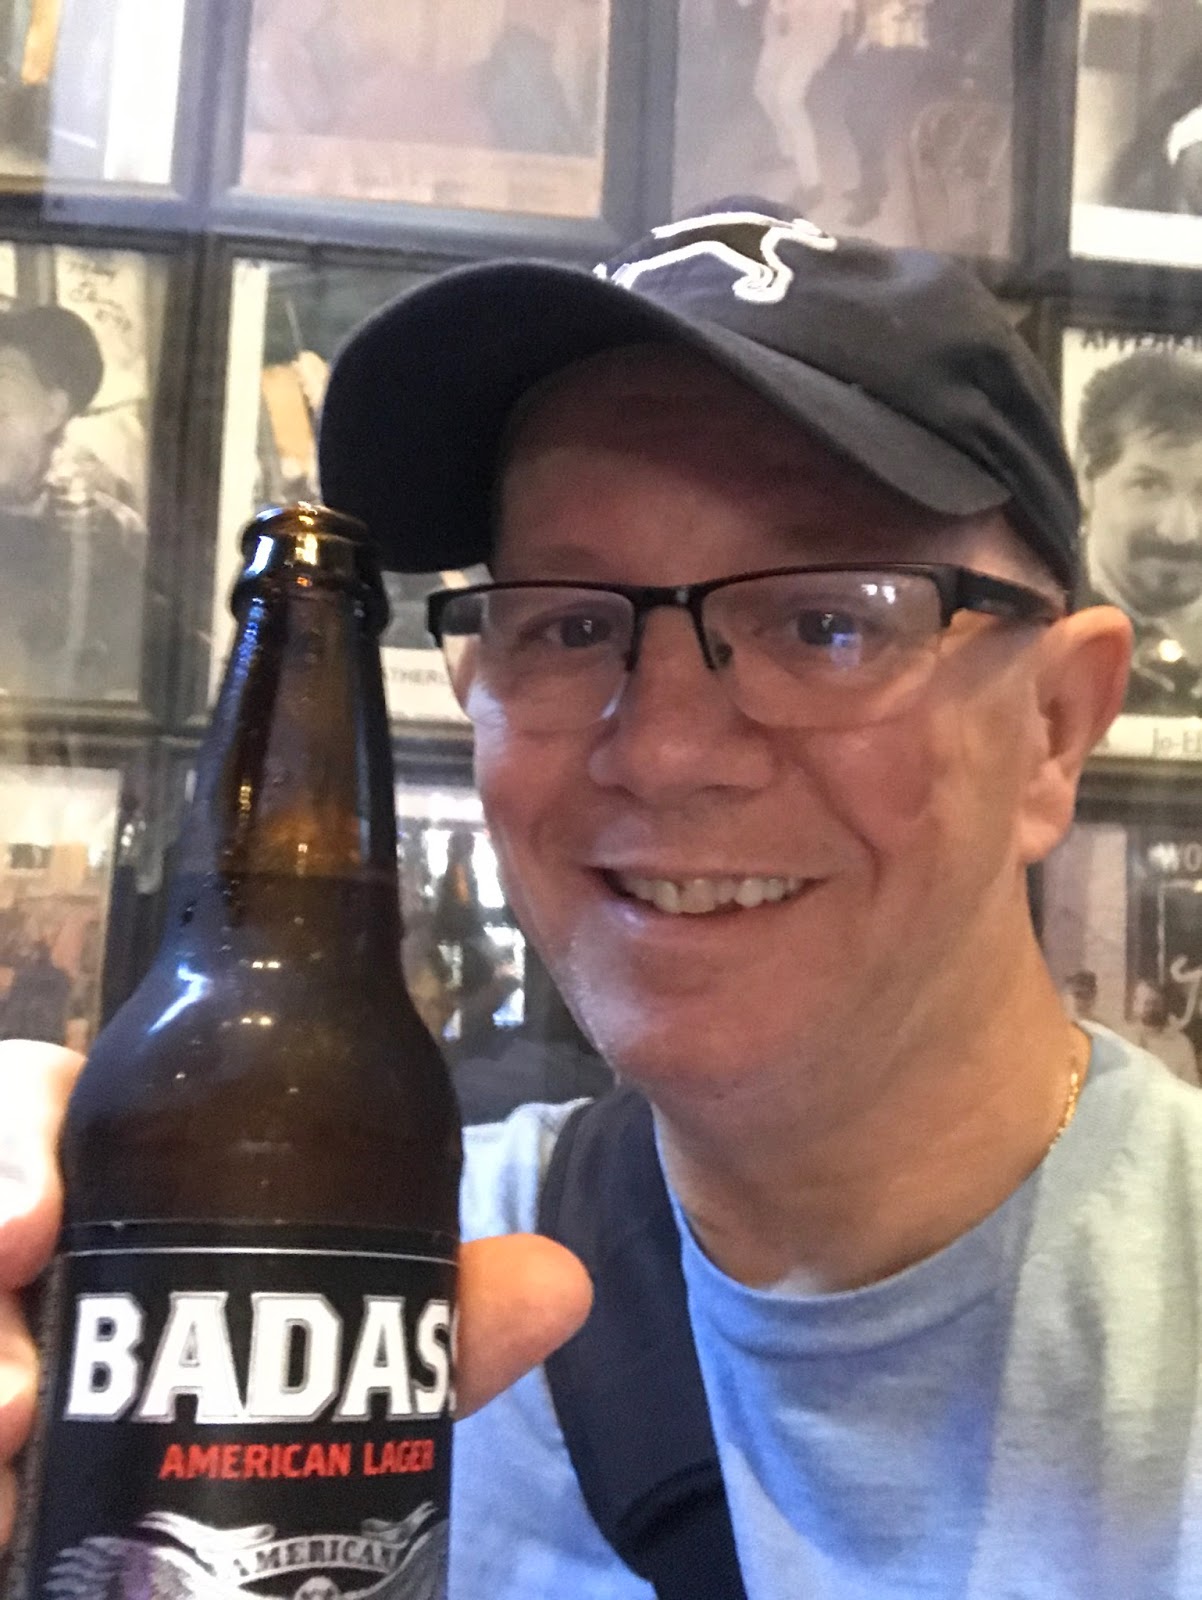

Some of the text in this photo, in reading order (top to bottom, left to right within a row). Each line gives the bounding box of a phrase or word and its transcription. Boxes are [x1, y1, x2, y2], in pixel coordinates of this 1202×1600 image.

[65, 1291, 458, 1423] BADAS
[159, 1439, 434, 1479] AMERICAN LAGER
[231, 1539, 398, 1578] AMERICAN
